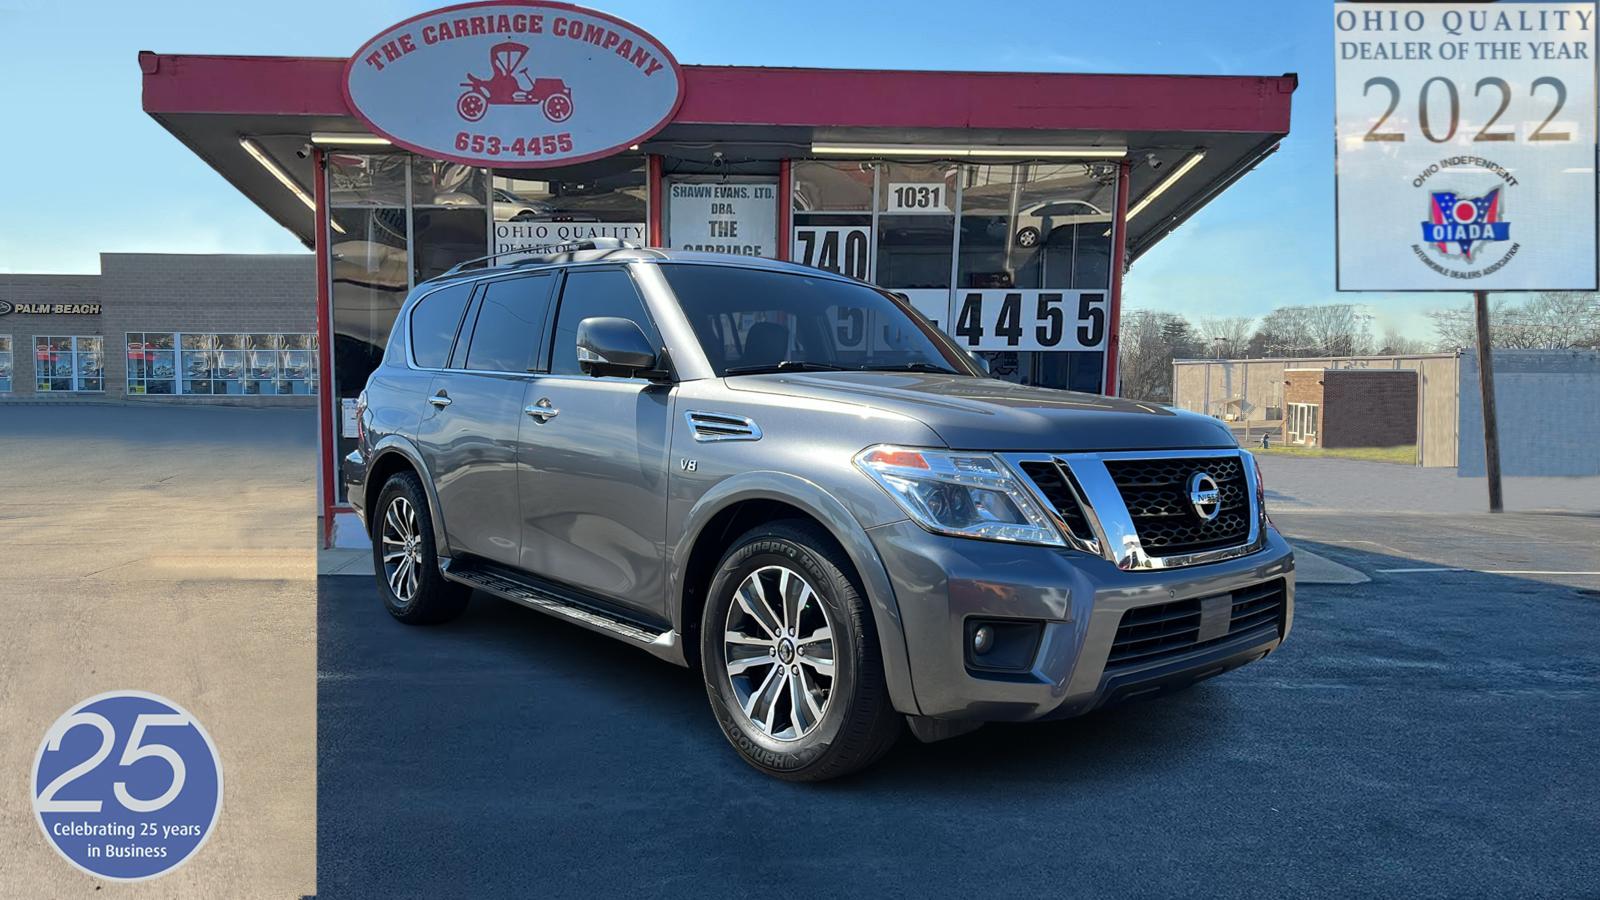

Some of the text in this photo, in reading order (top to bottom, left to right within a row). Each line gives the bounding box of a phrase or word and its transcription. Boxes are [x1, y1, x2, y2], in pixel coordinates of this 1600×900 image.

[1336, 10, 1592, 36] OHIO QUALITY
[366, 14, 663, 77] THE CARRIAGE COMPANY
[1340, 42, 1588, 60] DEALER OF THE YEAR
[1363, 76, 1570, 142] 2022
[455, 132, 573, 156] 653-4455
[1412, 155, 1519, 188] OHIO INDEPENDENT
[673, 186, 712, 199] SHAWN
[754, 187, 775, 199] LTD.
[894, 186, 940, 208] 1031
[711, 203, 736, 215] DBA.
[497, 226, 643, 241] OHIO QUALITY
[708, 220, 738, 238] THE
[1432, 224, 1495, 240] OIADA
[797, 230, 867, 281] 740
[1450, 269, 1483, 280] DEALERS
[15, 304, 51, 314] PALM
[54, 304, 100, 314] BEACH
[956, 293, 1105, 347] 4455
[680, 458, 698, 471] V8
